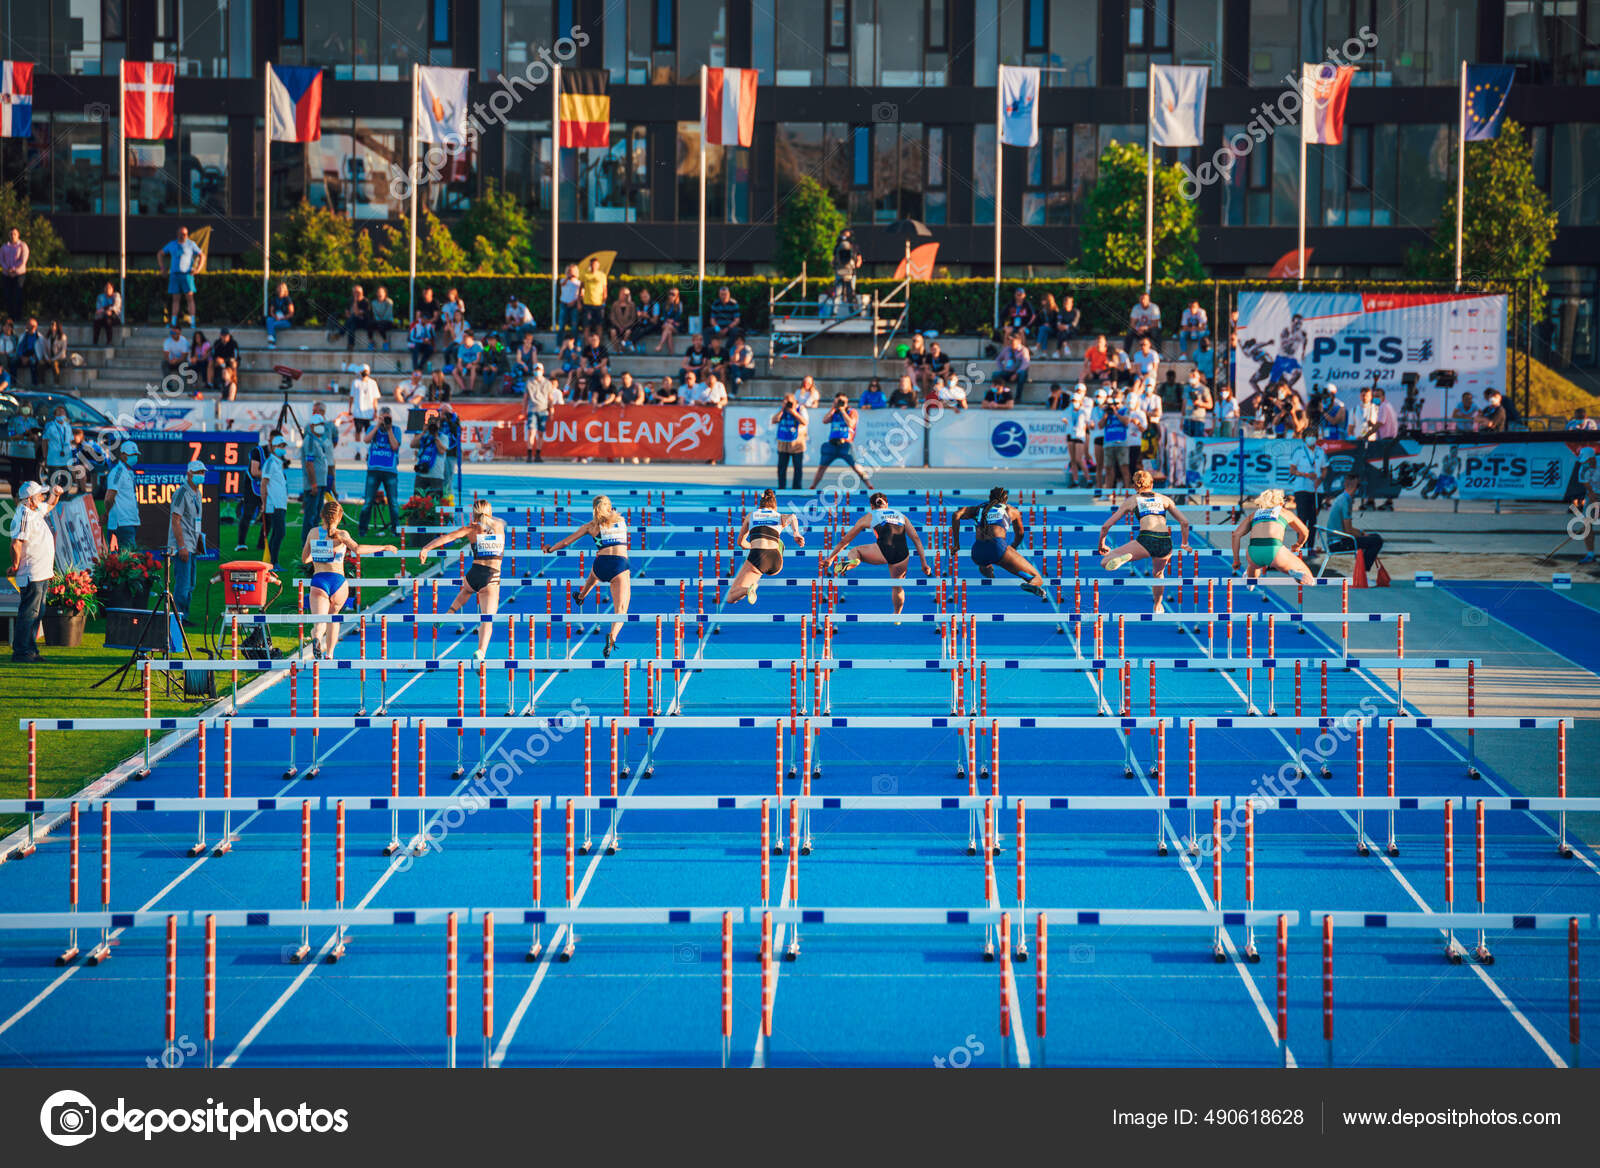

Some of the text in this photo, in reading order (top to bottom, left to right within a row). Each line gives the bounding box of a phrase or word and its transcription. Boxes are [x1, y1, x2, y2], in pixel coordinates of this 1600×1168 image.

[1312, 336, 1404, 365] P-T-S
[1311, 368, 1323, 380] 2.
[1363, 368, 1395, 380] 2021
[584, 420, 675, 444] CLEAN
[1465, 457, 1528, 477] P-T-S
[225, 471, 240, 494] H
[1464, 477, 1497, 489] 2021
